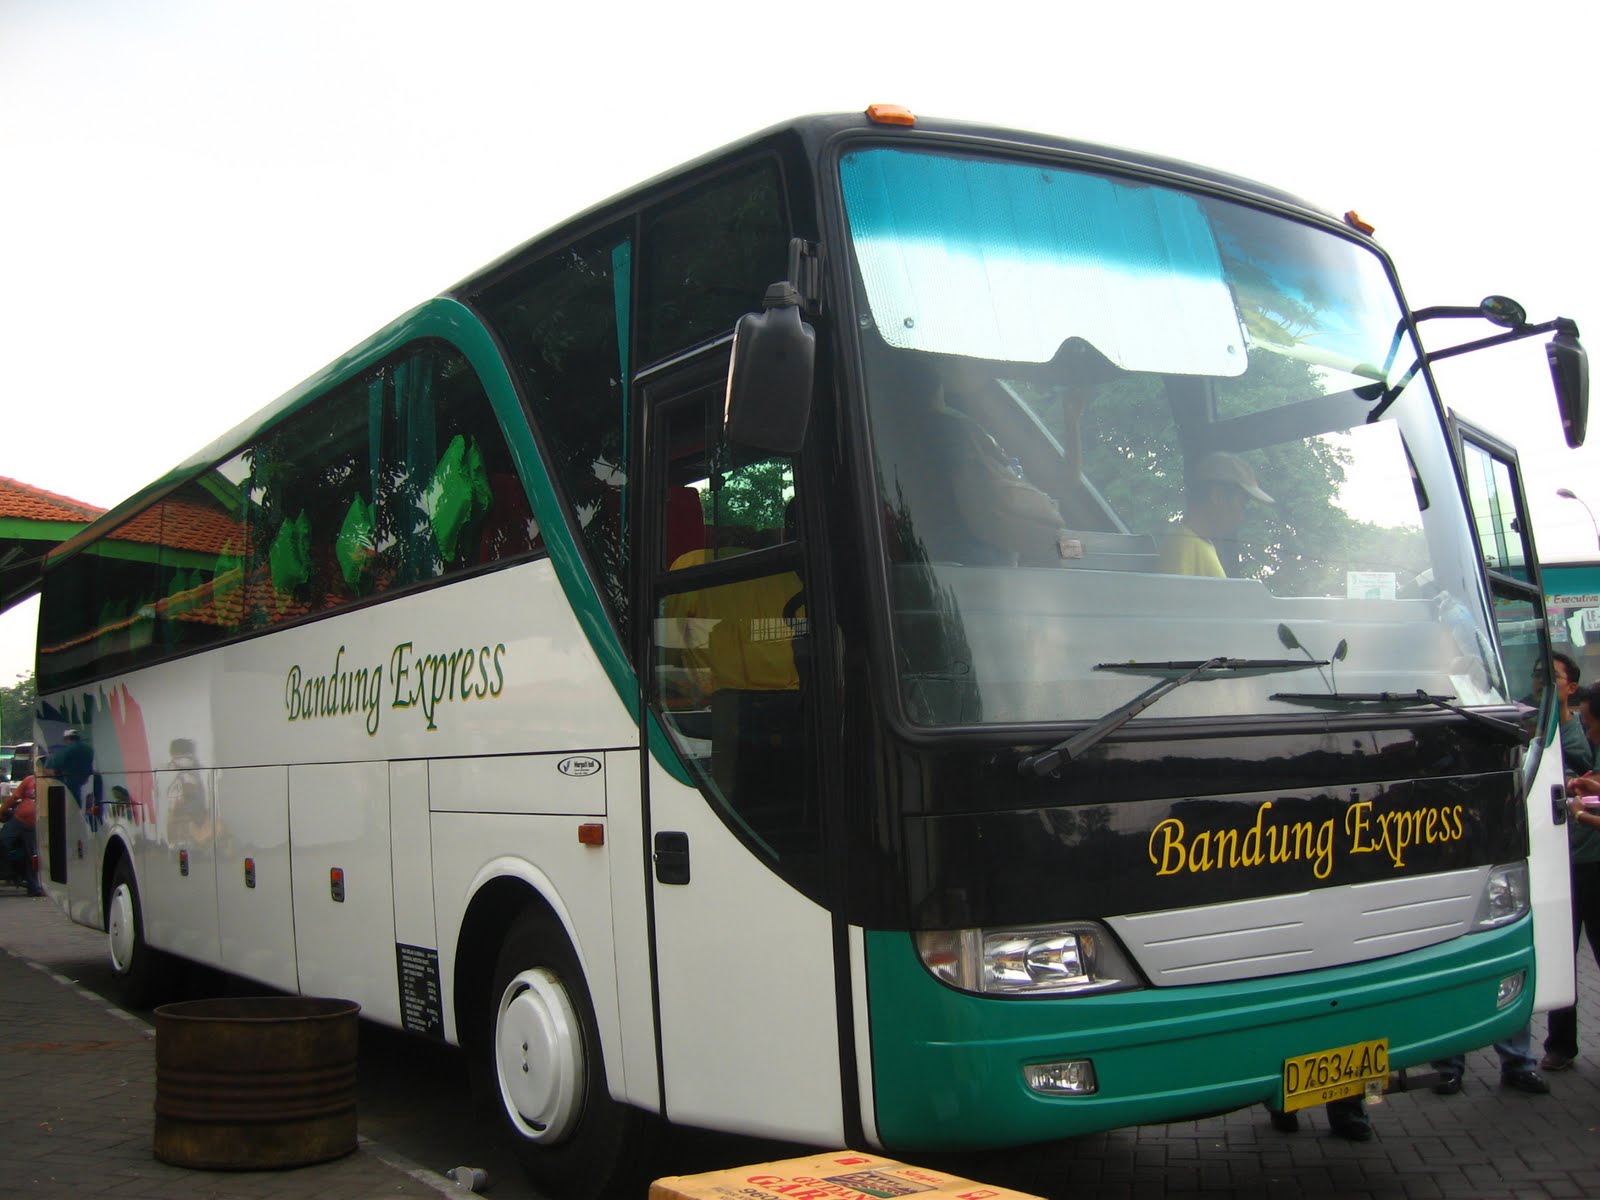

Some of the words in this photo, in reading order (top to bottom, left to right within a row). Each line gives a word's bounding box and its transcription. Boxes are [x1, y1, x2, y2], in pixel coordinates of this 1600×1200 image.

[1553, 593, 1599, 604] Executive
[286, 645, 383, 737] Bandung
[390, 641, 506, 731] Express
[1149, 801, 1335, 879] Bandung
[1345, 801, 1464, 868] Express
[1286, 1062, 1299, 1093] D
[1304, 1050, 1354, 1090] 7634
[1360, 1044, 1386, 1077] AC
